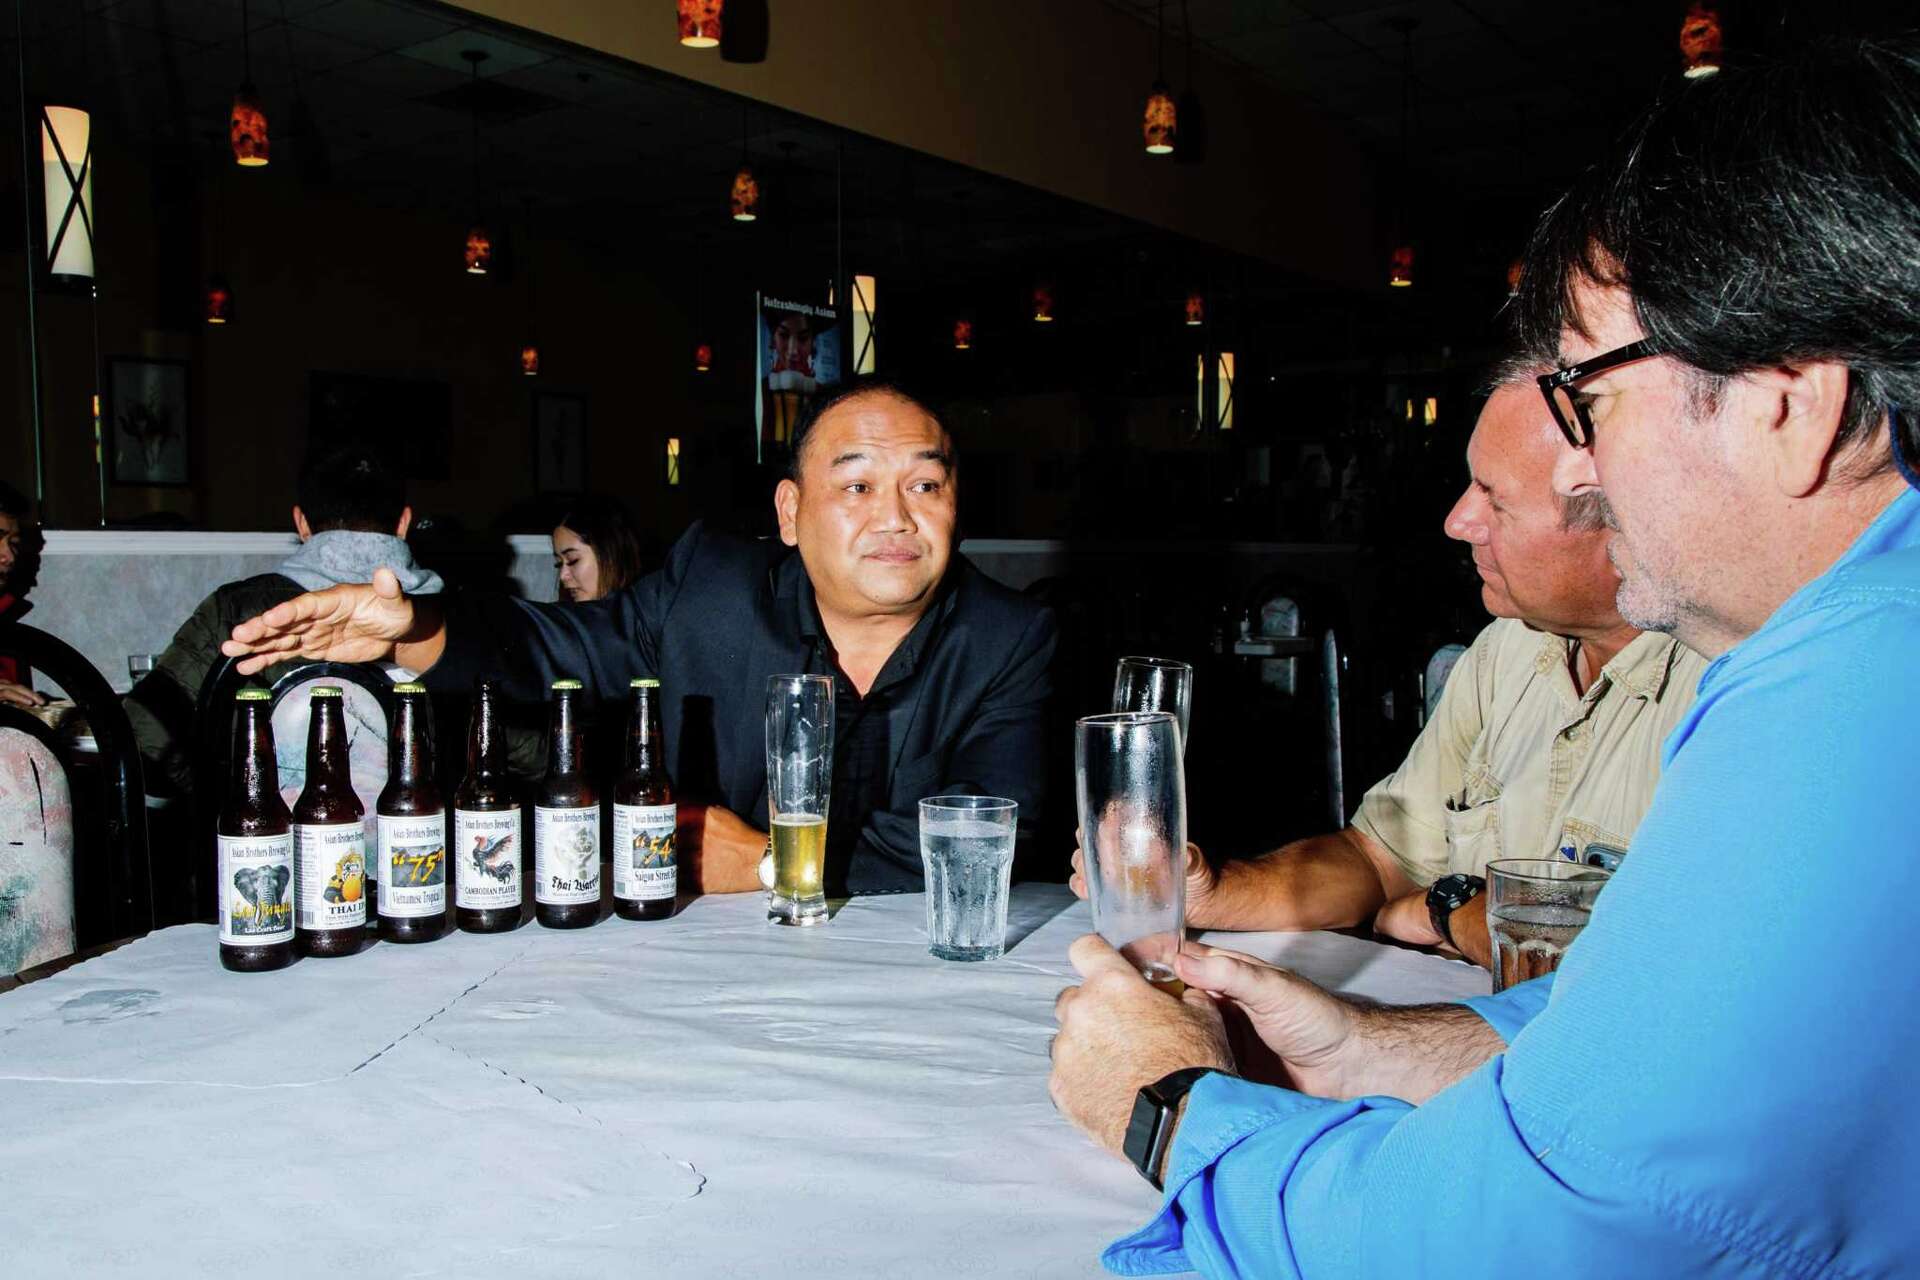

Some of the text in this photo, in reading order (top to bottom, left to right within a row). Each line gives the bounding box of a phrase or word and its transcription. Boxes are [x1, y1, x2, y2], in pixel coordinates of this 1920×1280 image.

[465, 884, 516, 896] CAMBODIAN PLAYER
[552, 876, 572, 891] Thai
[392, 890, 422, 906] Vietnamese
[328, 904, 357, 915] THAI
